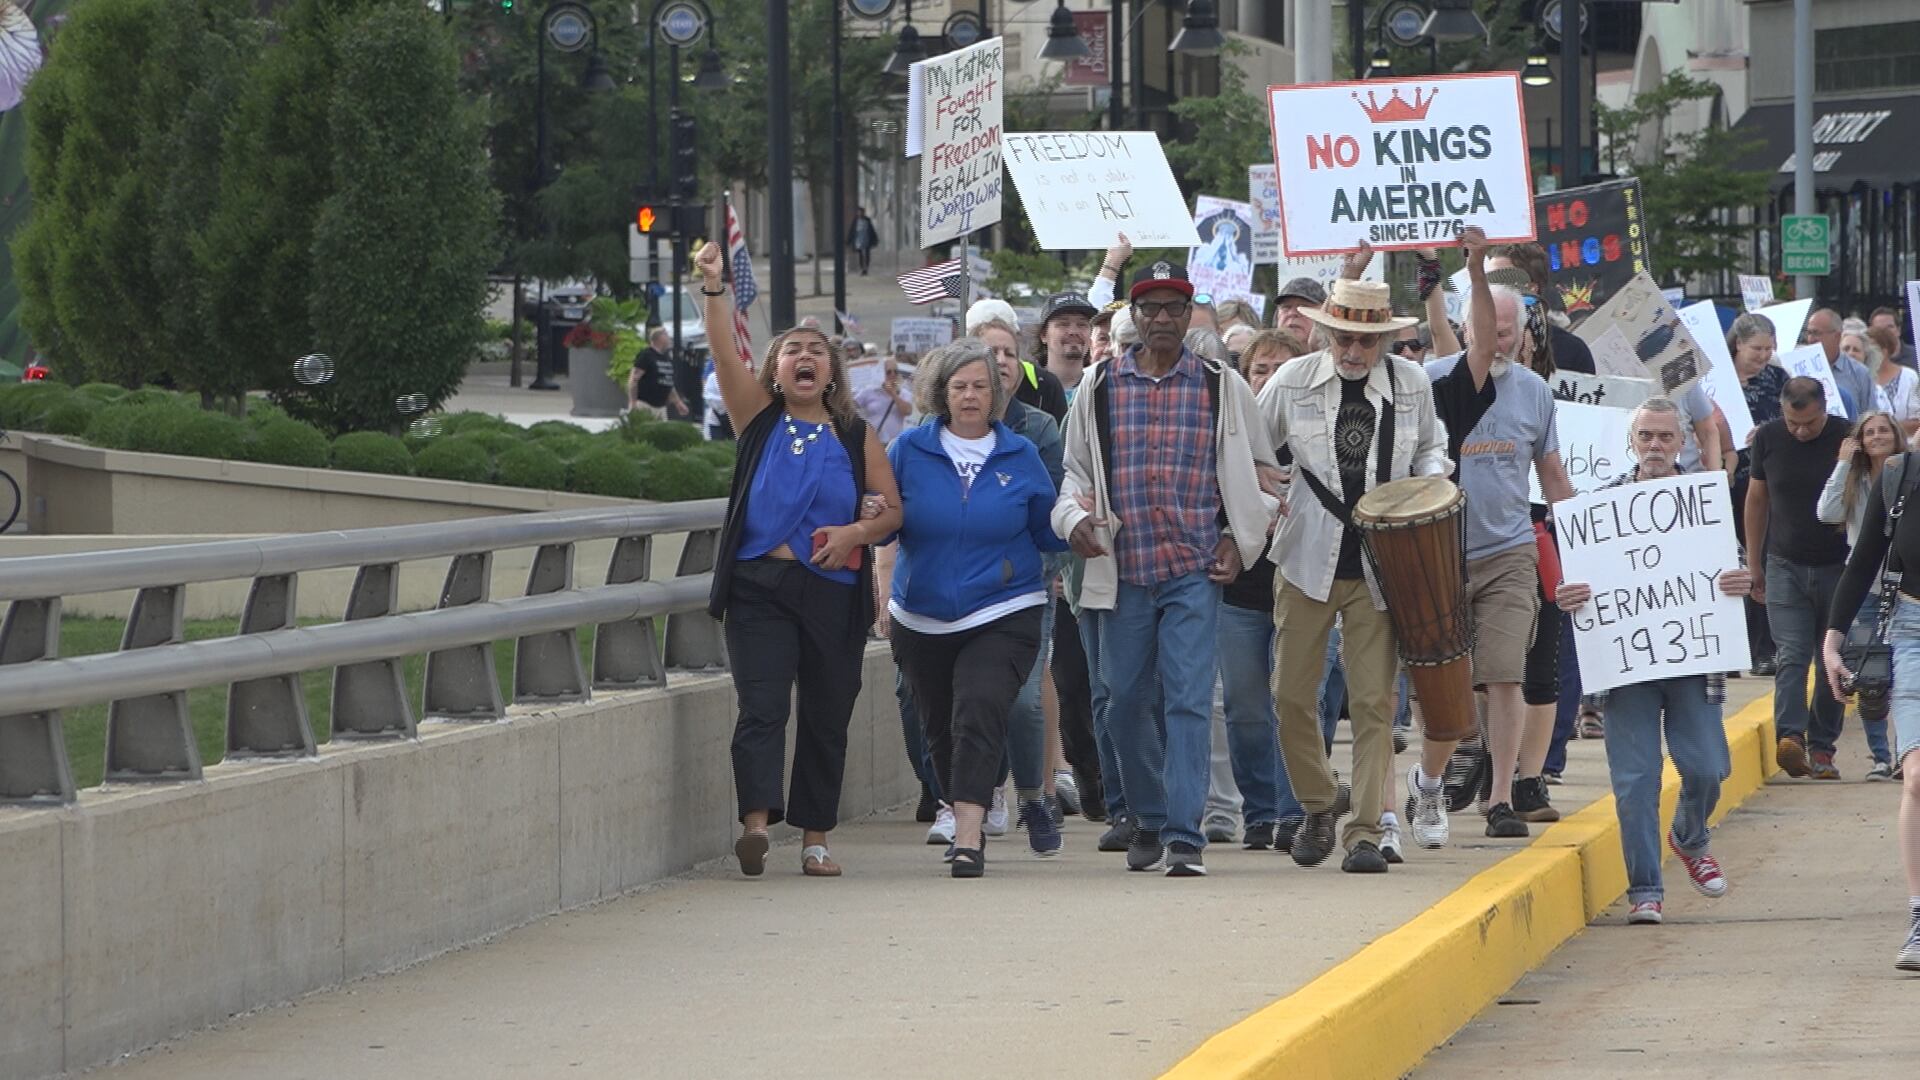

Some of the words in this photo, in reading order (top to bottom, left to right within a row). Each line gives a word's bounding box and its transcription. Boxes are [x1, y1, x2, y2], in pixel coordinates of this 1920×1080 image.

[952, 106, 983, 141] FOR
[1007, 133, 1132, 164] FREEDOM
[1306, 133, 1360, 170] NO
[1373, 124, 1492, 166] KINGS
[928, 176, 954, 206] FOR
[956, 159, 981, 192] ALL
[983, 151, 1002, 177] IN
[1400, 165, 1416, 184] IN
[928, 191, 976, 230] WORLD
[976, 177, 1003, 206] WAR
[1331, 178, 1496, 224] AMERICA
[1546, 200, 1589, 232] NO
[955, 207, 975, 235] II
[1369, 223, 1419, 242] SINCE
[1424, 218, 1466, 240] 1776
[1548, 234, 1621, 272] INGS
[1787, 256, 1825, 269] BEGIN
[1558, 482, 1721, 550] WELCOME
[1625, 544, 1661, 571] TO
[1572, 568, 1723, 632] GERMANY
